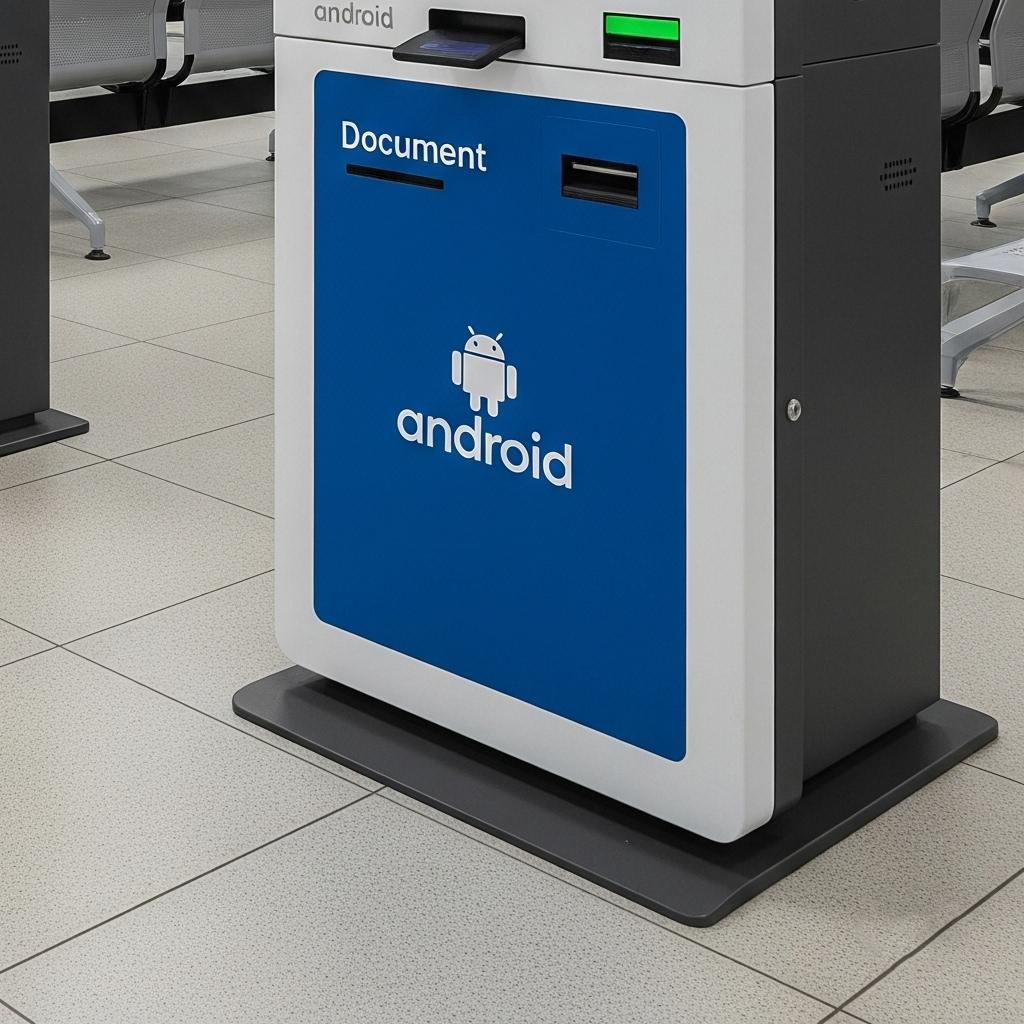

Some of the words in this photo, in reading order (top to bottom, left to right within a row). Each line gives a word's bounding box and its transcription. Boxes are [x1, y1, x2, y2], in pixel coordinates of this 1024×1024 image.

[314, 2, 394, 30] android
[341, 120, 487, 173] Document
[397, 408, 573, 490] android
